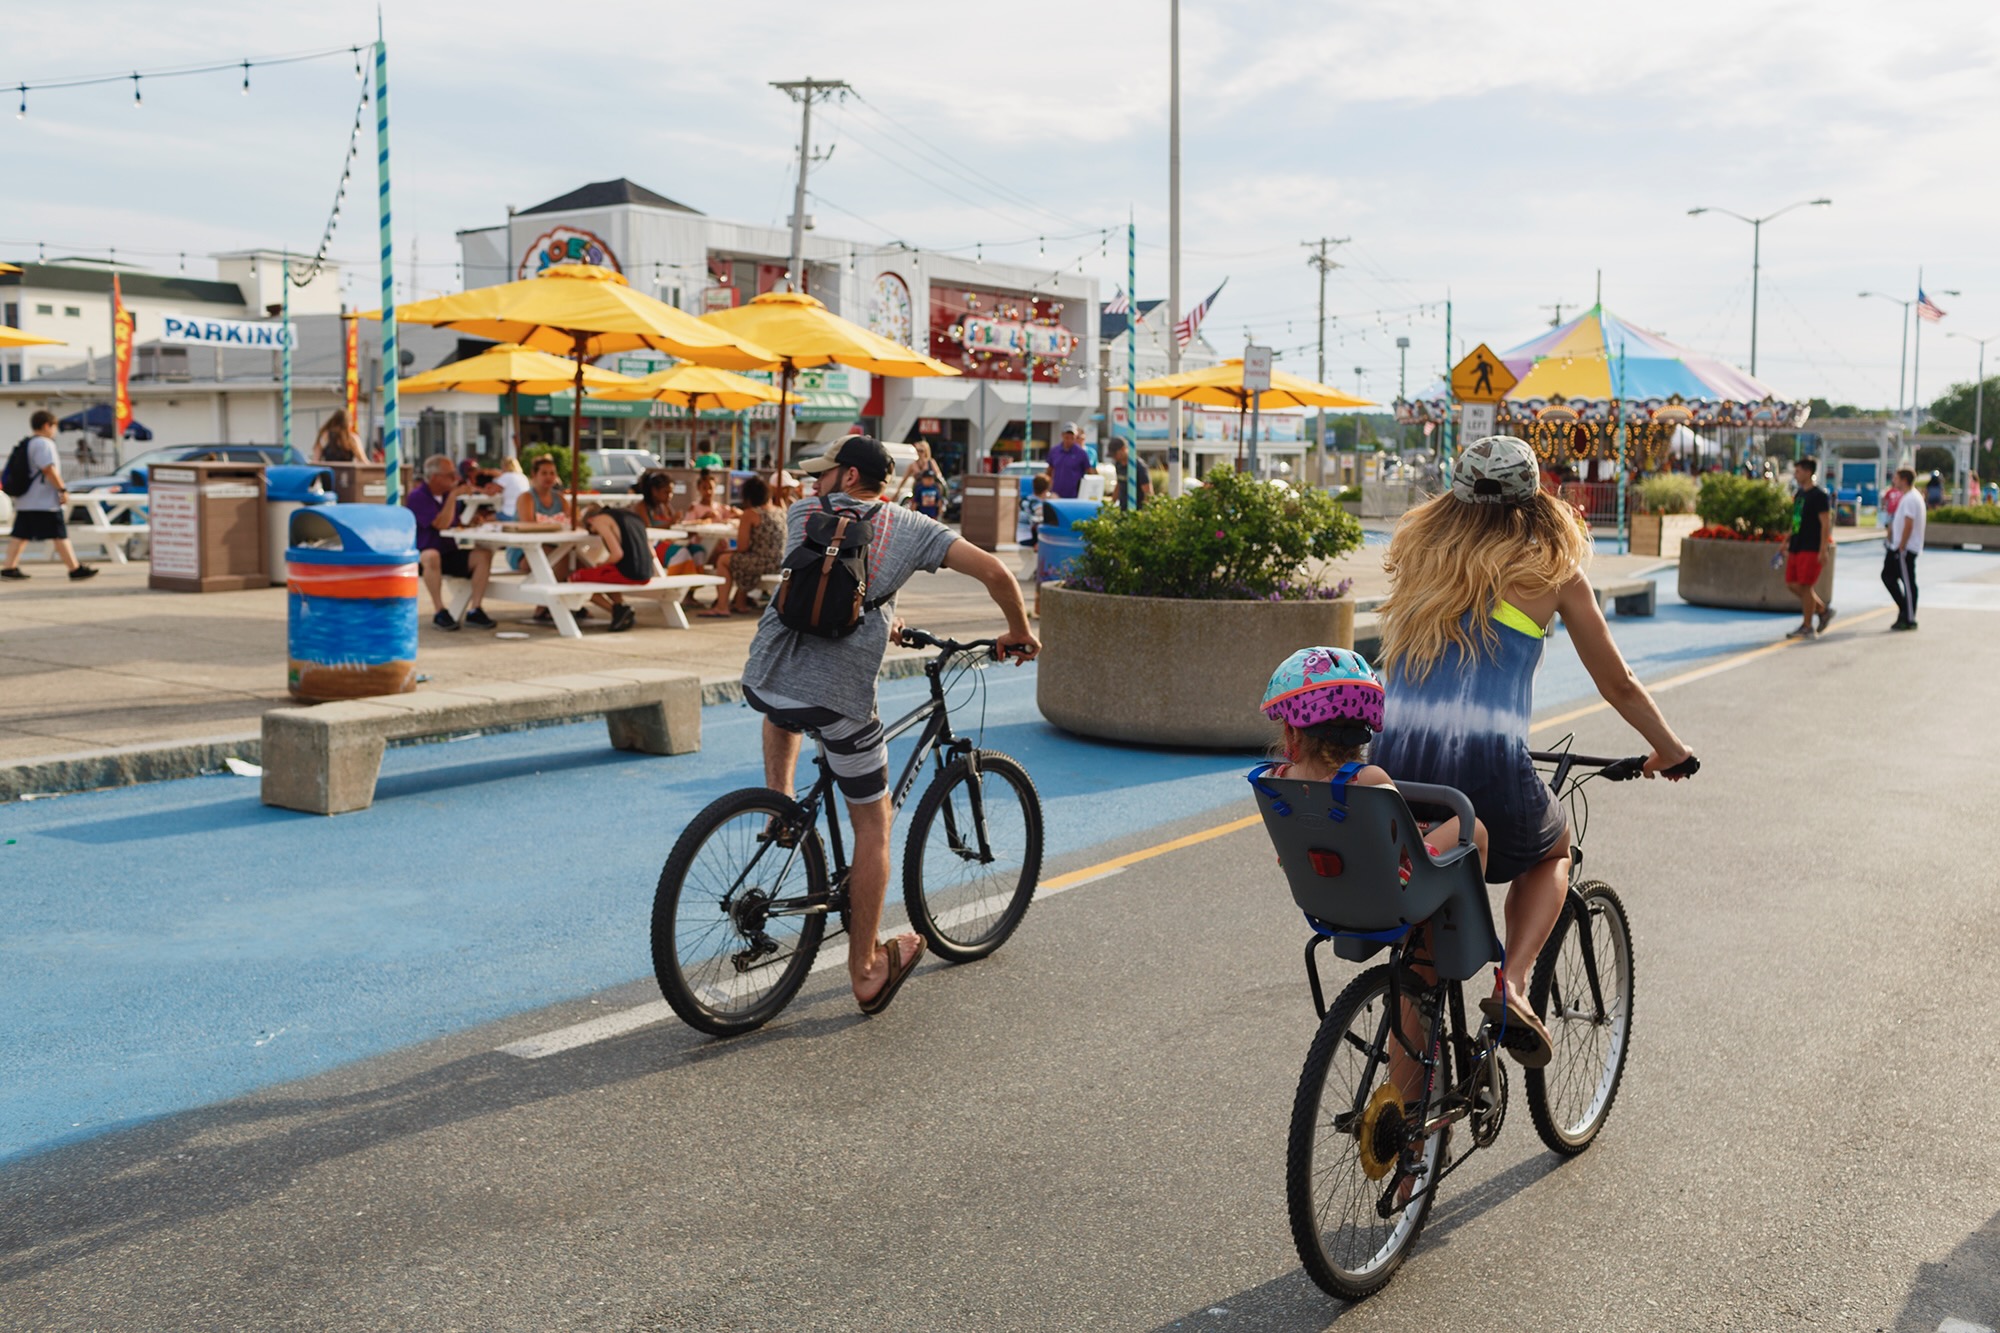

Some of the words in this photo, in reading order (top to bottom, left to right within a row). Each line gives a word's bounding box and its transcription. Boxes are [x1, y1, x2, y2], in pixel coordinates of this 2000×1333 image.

[164, 318, 293, 345] PARKING
[1472, 408, 1486, 417] NO
[1466, 421, 1488, 430] LEFT
